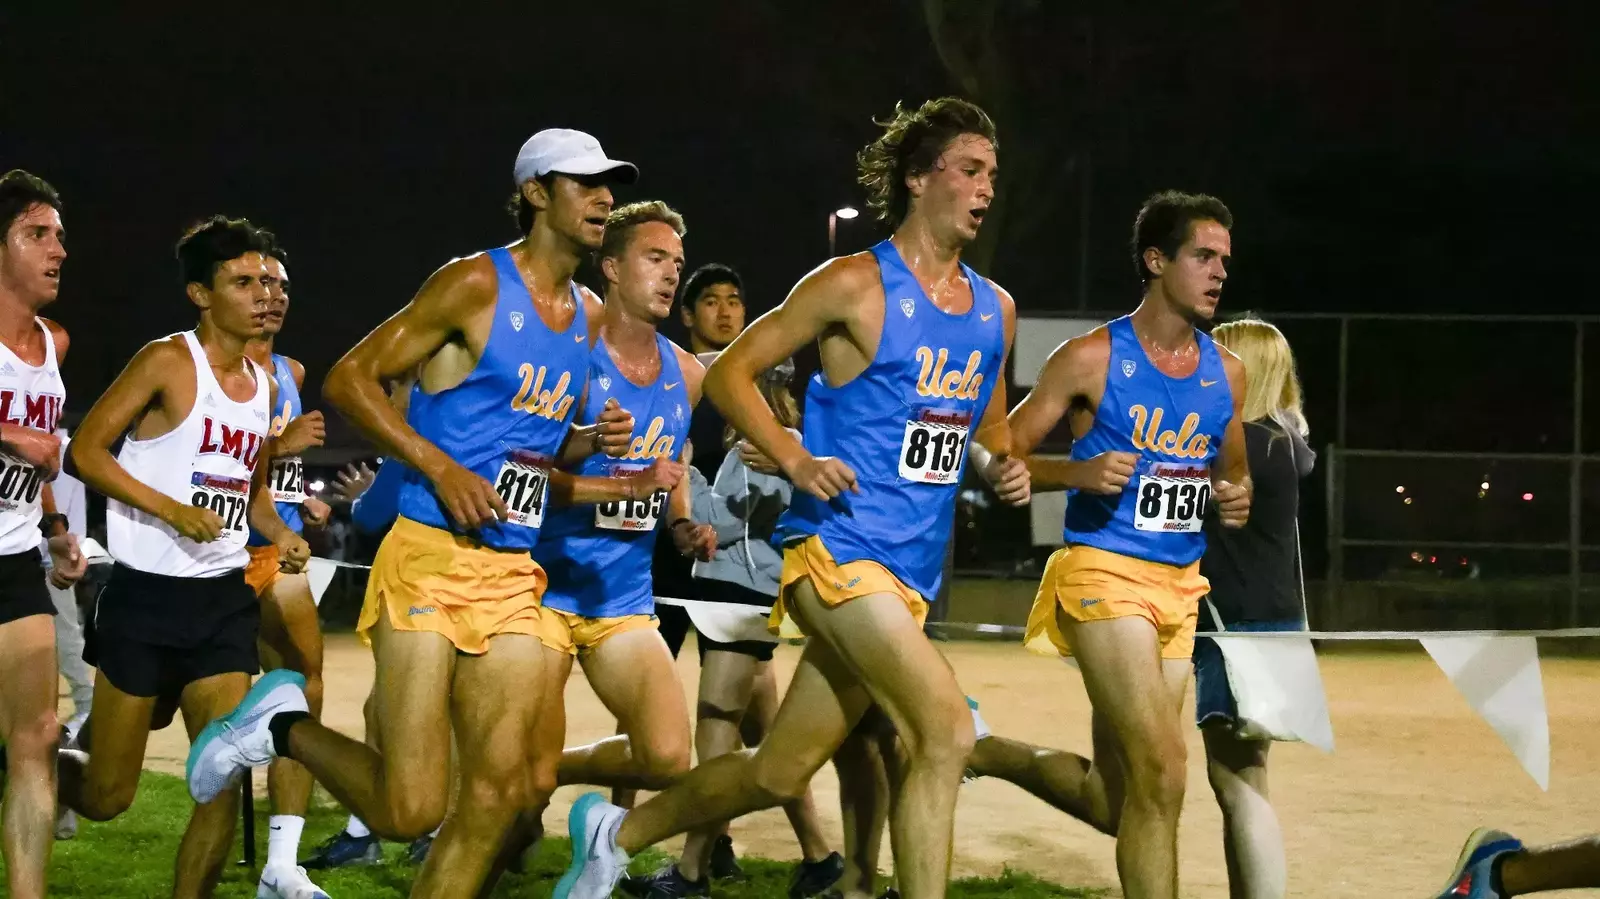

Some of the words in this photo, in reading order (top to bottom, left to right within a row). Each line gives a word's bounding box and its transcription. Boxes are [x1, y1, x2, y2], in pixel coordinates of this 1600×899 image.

[511, 362, 575, 422] Ucla
[916, 346, 983, 401] Ucla
[0, 388, 62, 434] LMU
[1129, 404, 1211, 459] Ucla
[196, 414, 266, 473] LMU
[606, 416, 675, 460] cla
[905, 428, 968, 472] 8131
[496, 468, 547, 516] 8124
[1139, 482, 1210, 521] 8130
